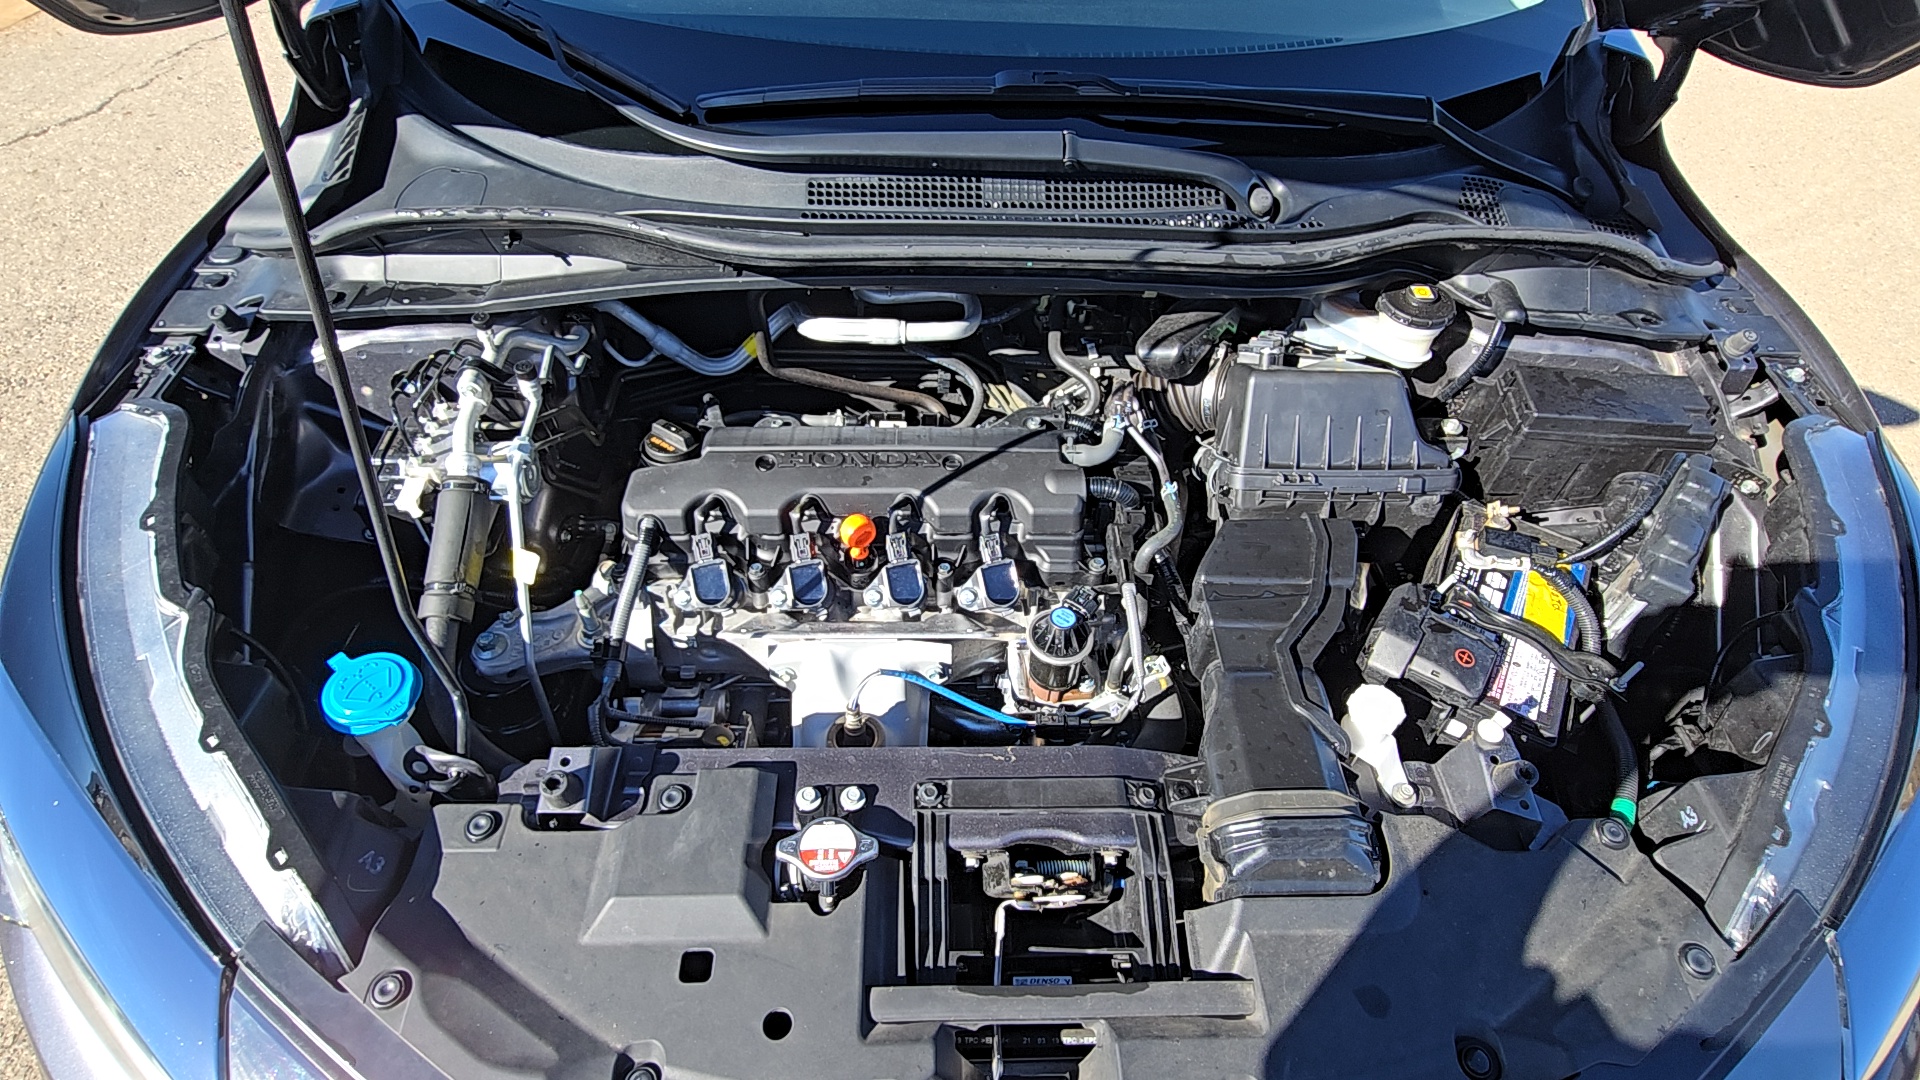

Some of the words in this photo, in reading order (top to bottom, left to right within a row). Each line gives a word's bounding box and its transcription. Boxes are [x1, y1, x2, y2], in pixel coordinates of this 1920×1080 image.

[777, 451, 941, 468] HONDA
[384, 700, 406, 716] PULL
[357, 849, 385, 874] A3
